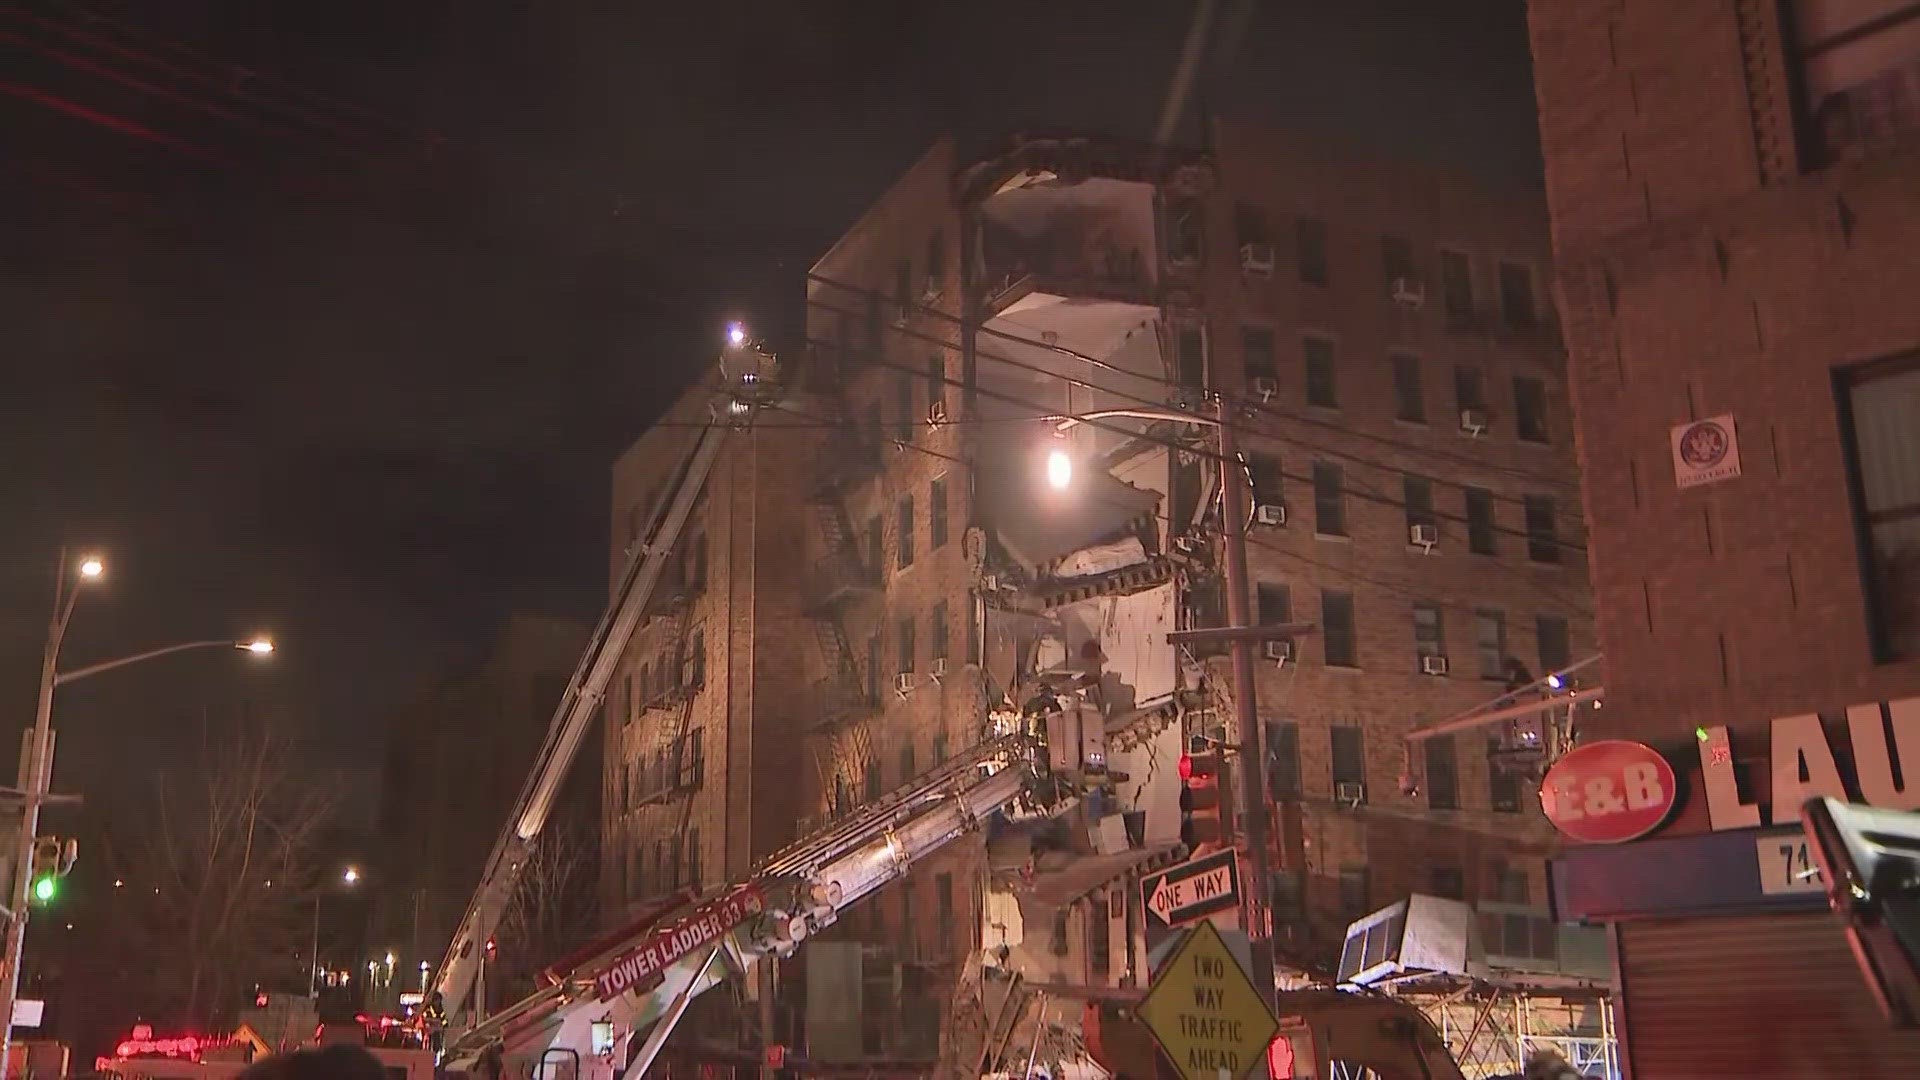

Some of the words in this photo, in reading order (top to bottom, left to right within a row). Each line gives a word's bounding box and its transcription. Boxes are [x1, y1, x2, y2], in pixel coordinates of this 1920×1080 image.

[1697, 698, 1920, 832] LAU
[1554, 763, 1664, 821] E&B
[1157, 885, 1183, 912] ONE
[1194, 871, 1224, 900] WAY
[600, 948, 661, 994] TOWER
[660, 914, 722, 963] LADDER
[722, 903, 741, 926] 33
[1194, 955, 1223, 979] TWO
[1194, 985, 1224, 1010] WAY
[1180, 1014, 1242, 1042] TRAFFIC
[1188, 1048, 1238, 1072] AHEAD
